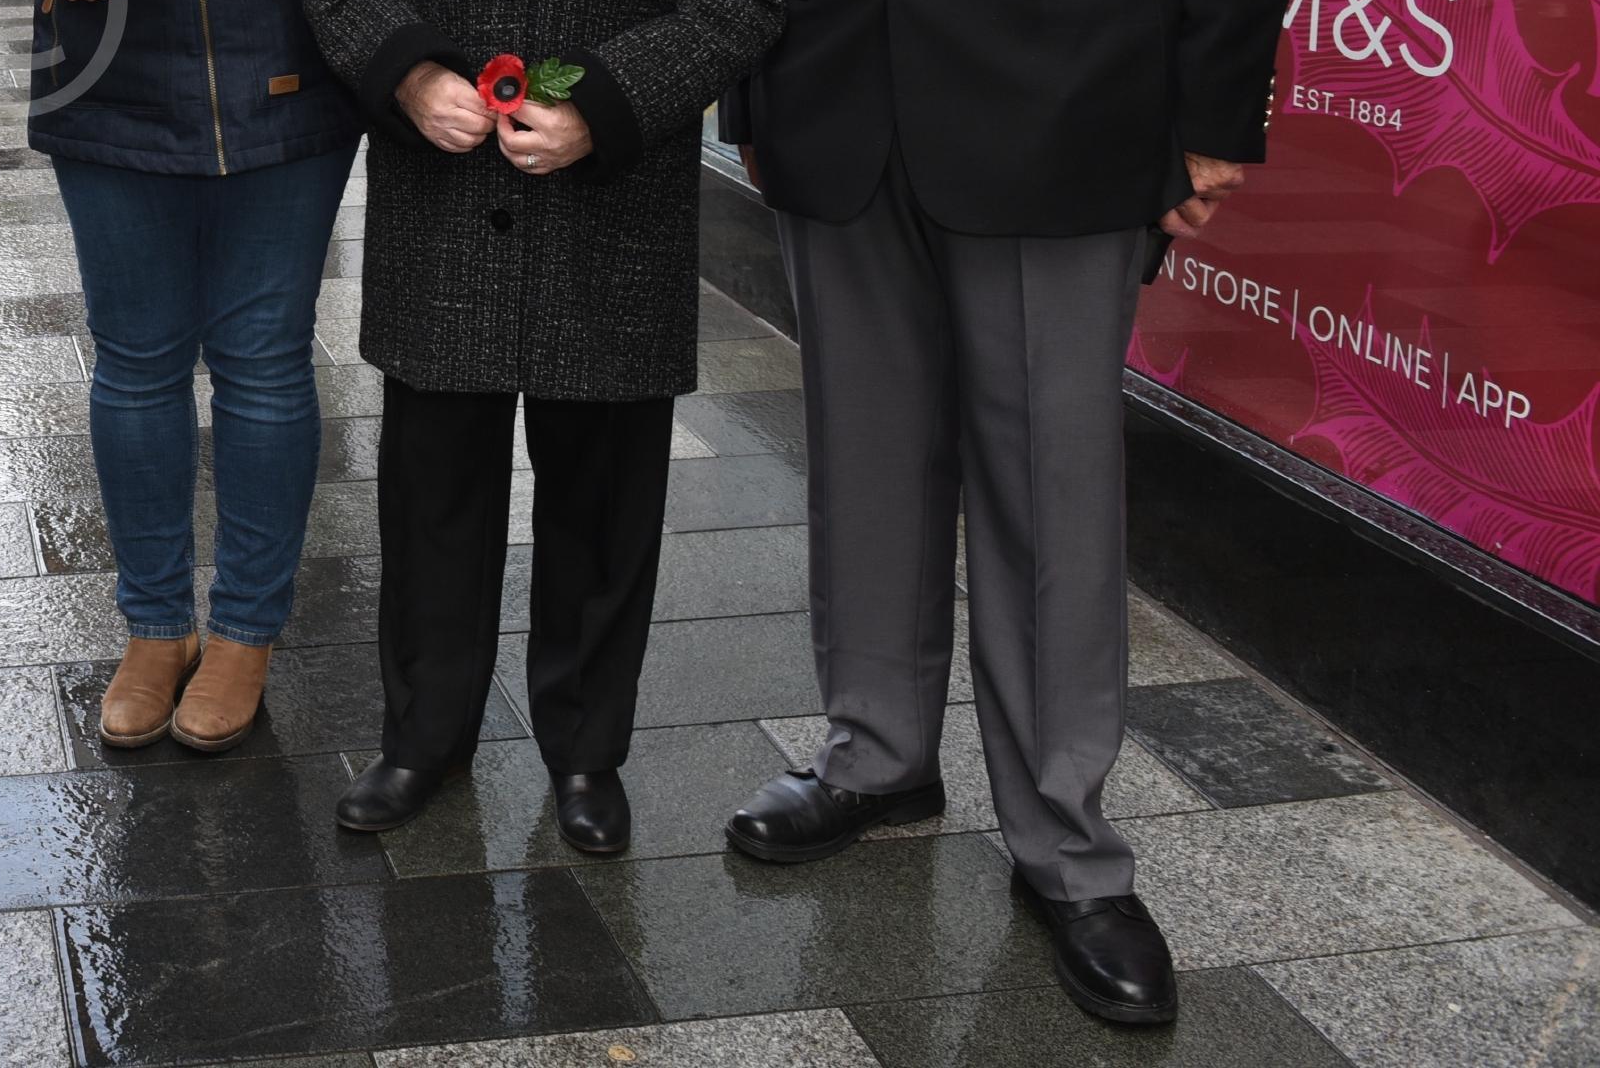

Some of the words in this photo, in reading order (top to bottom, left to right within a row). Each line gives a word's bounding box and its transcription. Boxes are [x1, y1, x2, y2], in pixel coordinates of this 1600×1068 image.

[1292, 84, 1340, 117] EST.
[1349, 97, 1403, 132] 1884
[1182, 256, 1282, 324] STORE
[1309, 305, 1431, 390] ONLINE
[1456, 372, 1531, 429] APP
